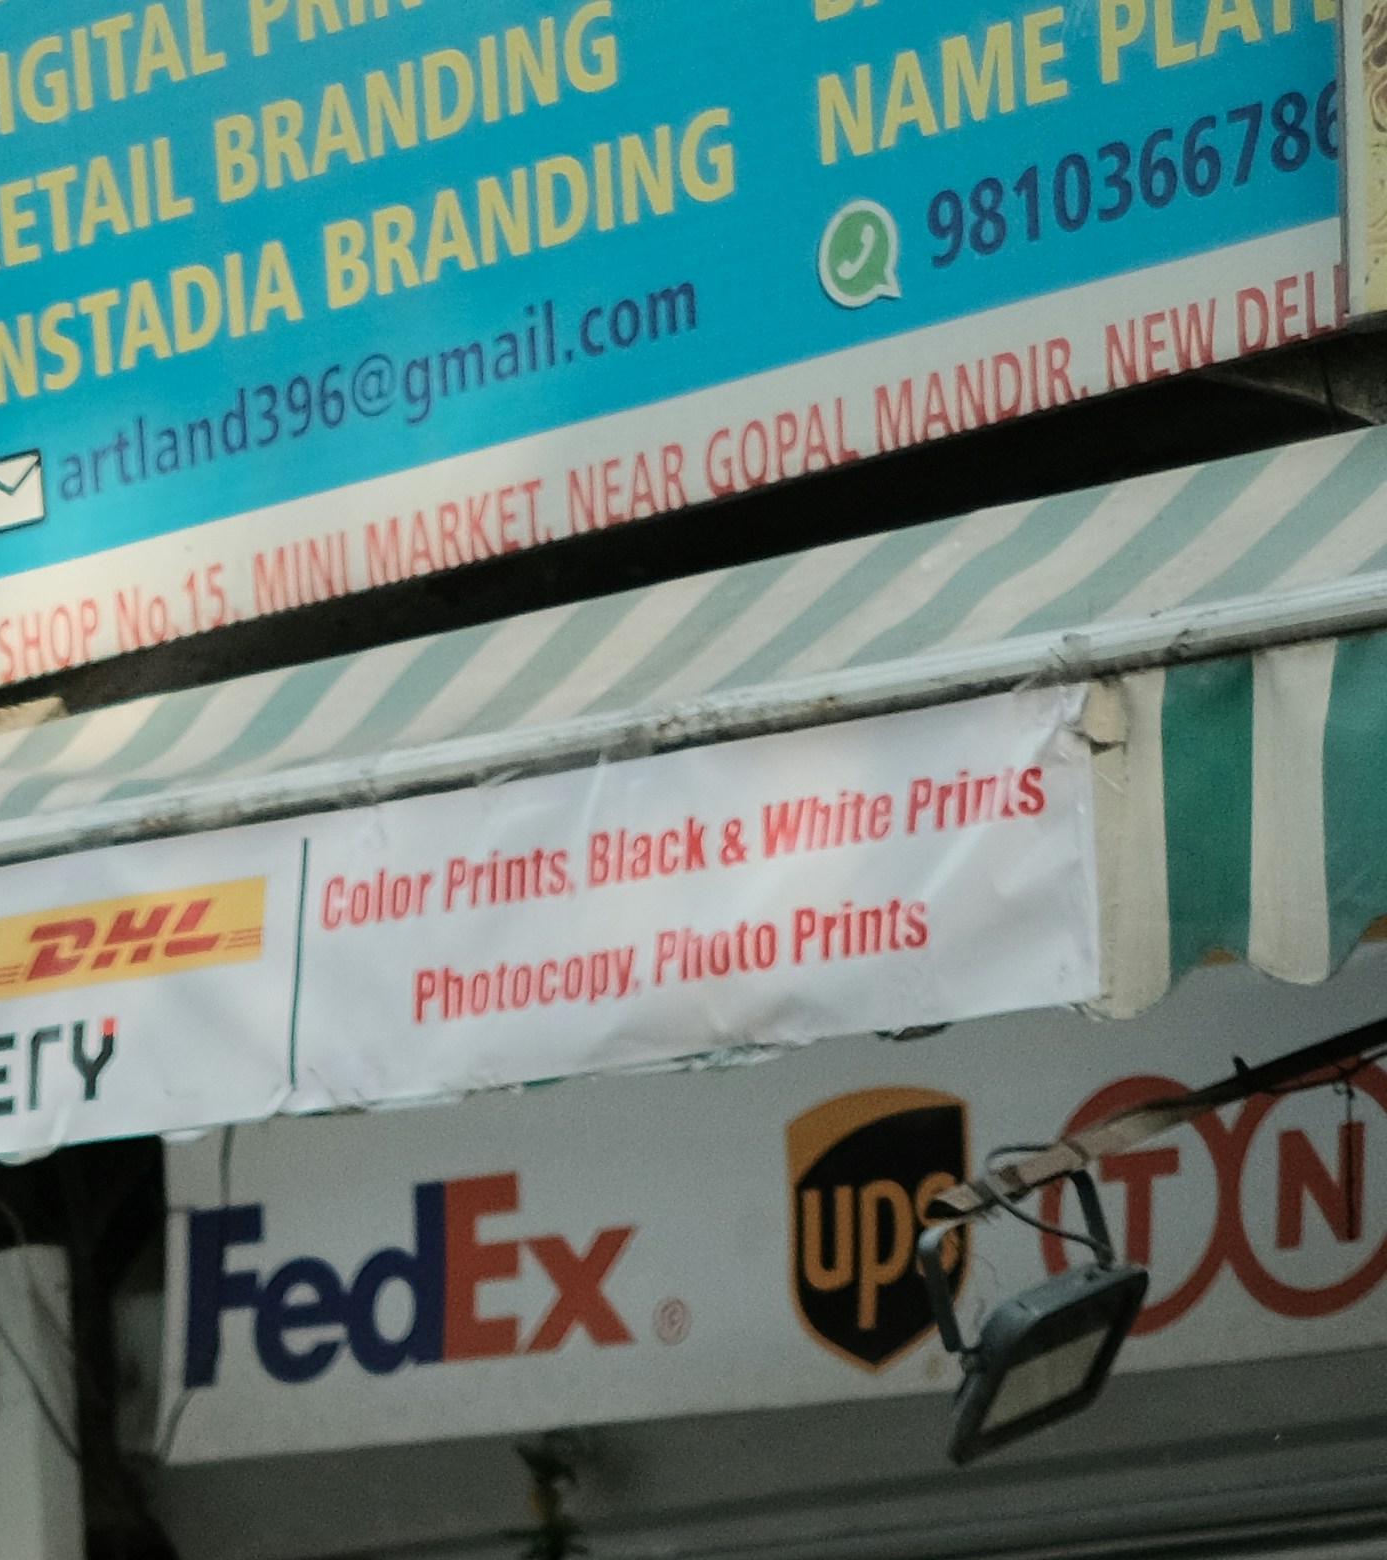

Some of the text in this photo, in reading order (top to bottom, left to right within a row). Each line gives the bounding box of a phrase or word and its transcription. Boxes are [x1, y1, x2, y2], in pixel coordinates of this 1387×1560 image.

[214, 0, 620, 204] BRANDING
[817, 0, 1337, 165] NAME PLA
[927, 80, 1340, 269] 9810366786
[323, 107, 736, 310] BRANDING
[58, 280, 697, 504] artland396@gmail.com
[251, 530, 349, 616] MINI
[567, 442, 688, 533] NEAR
[704, 397, 861, 499] GOPAL
[1106, 297, 1218, 390] NEW
[27, 898, 225, 982] DHL
[321, 867, 432, 931] Color
[587, 815, 705, 887] Black
[720, 818, 747, 866] &
[760, 788, 891, 859] White
[905, 765, 1047, 835] Prints
[653, 918, 776, 987] Photo
[792, 898, 928, 965] Prints
[184, 1171, 638, 1389] FedEx
